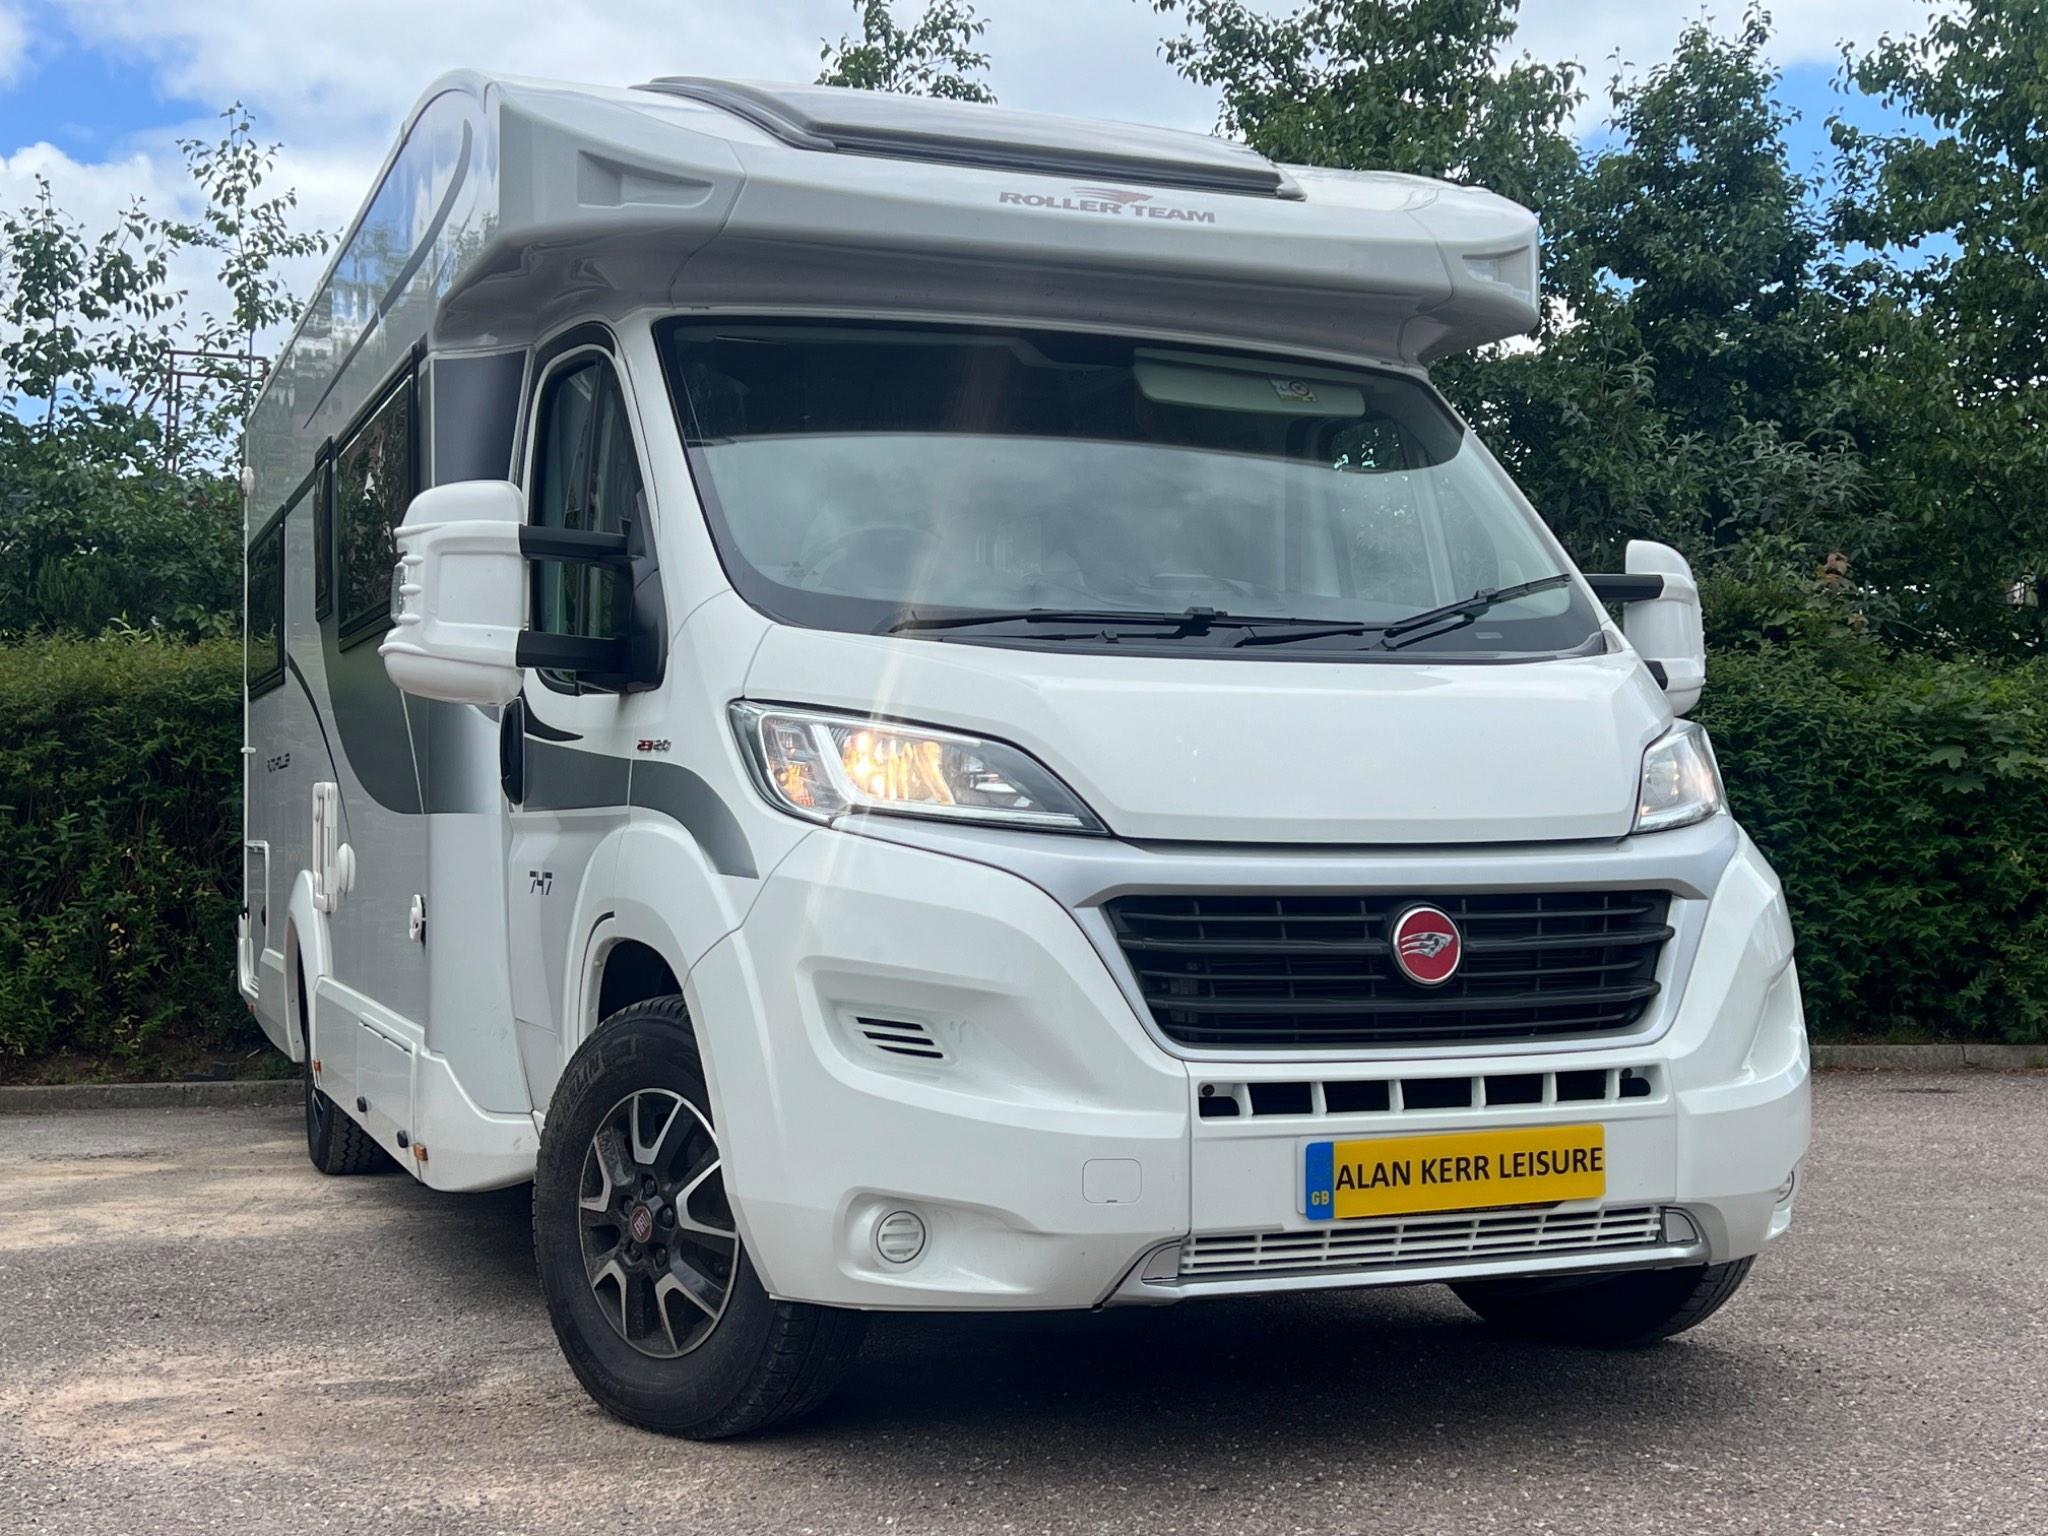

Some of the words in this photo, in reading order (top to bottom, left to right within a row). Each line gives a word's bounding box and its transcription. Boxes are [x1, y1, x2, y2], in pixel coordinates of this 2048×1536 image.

[999, 191, 1121, 214] ROLLER
[1130, 204, 1216, 223] TEAM
[1335, 1160, 1411, 1190] ALAN
[1421, 1155, 1490, 1184] KERR
[1499, 1147, 1603, 1179] LEISURE
[1311, 1190, 1330, 1205] GB
